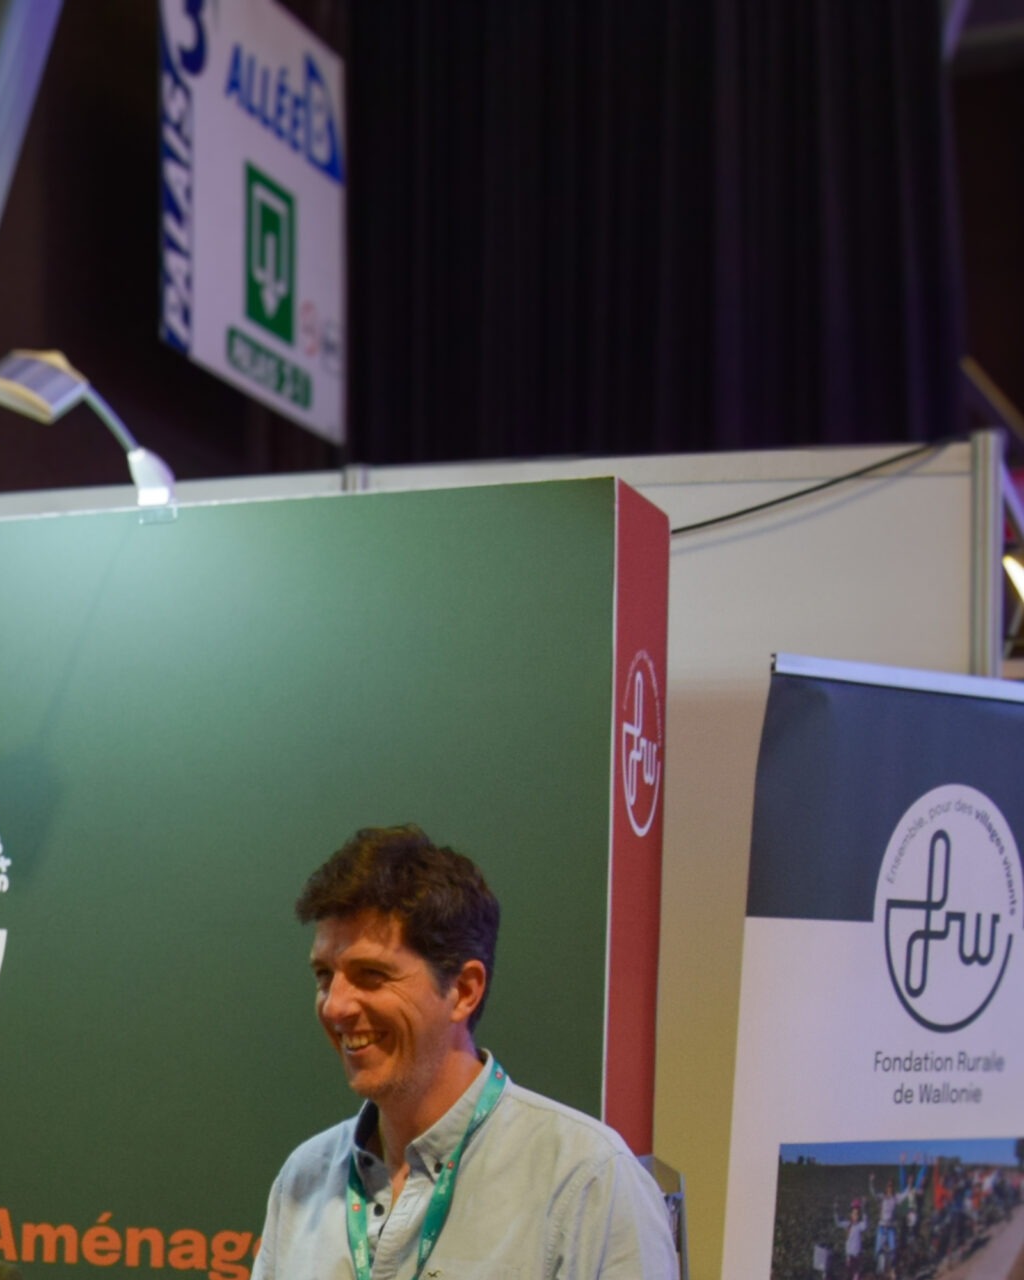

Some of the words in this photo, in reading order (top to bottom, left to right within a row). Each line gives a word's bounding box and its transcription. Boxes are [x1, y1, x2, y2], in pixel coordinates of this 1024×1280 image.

[928, 800, 953, 820] pour
[954, 798, 974, 816] des
[974, 808, 1005, 856] villages
[1002, 855, 1017, 917] vivants
[873, 1050, 954, 1073] Fondation
[956, 1050, 1005, 1073] Rurale
[893, 1082, 914, 1105] de
[918, 1082, 984, 1105] Wallonie
